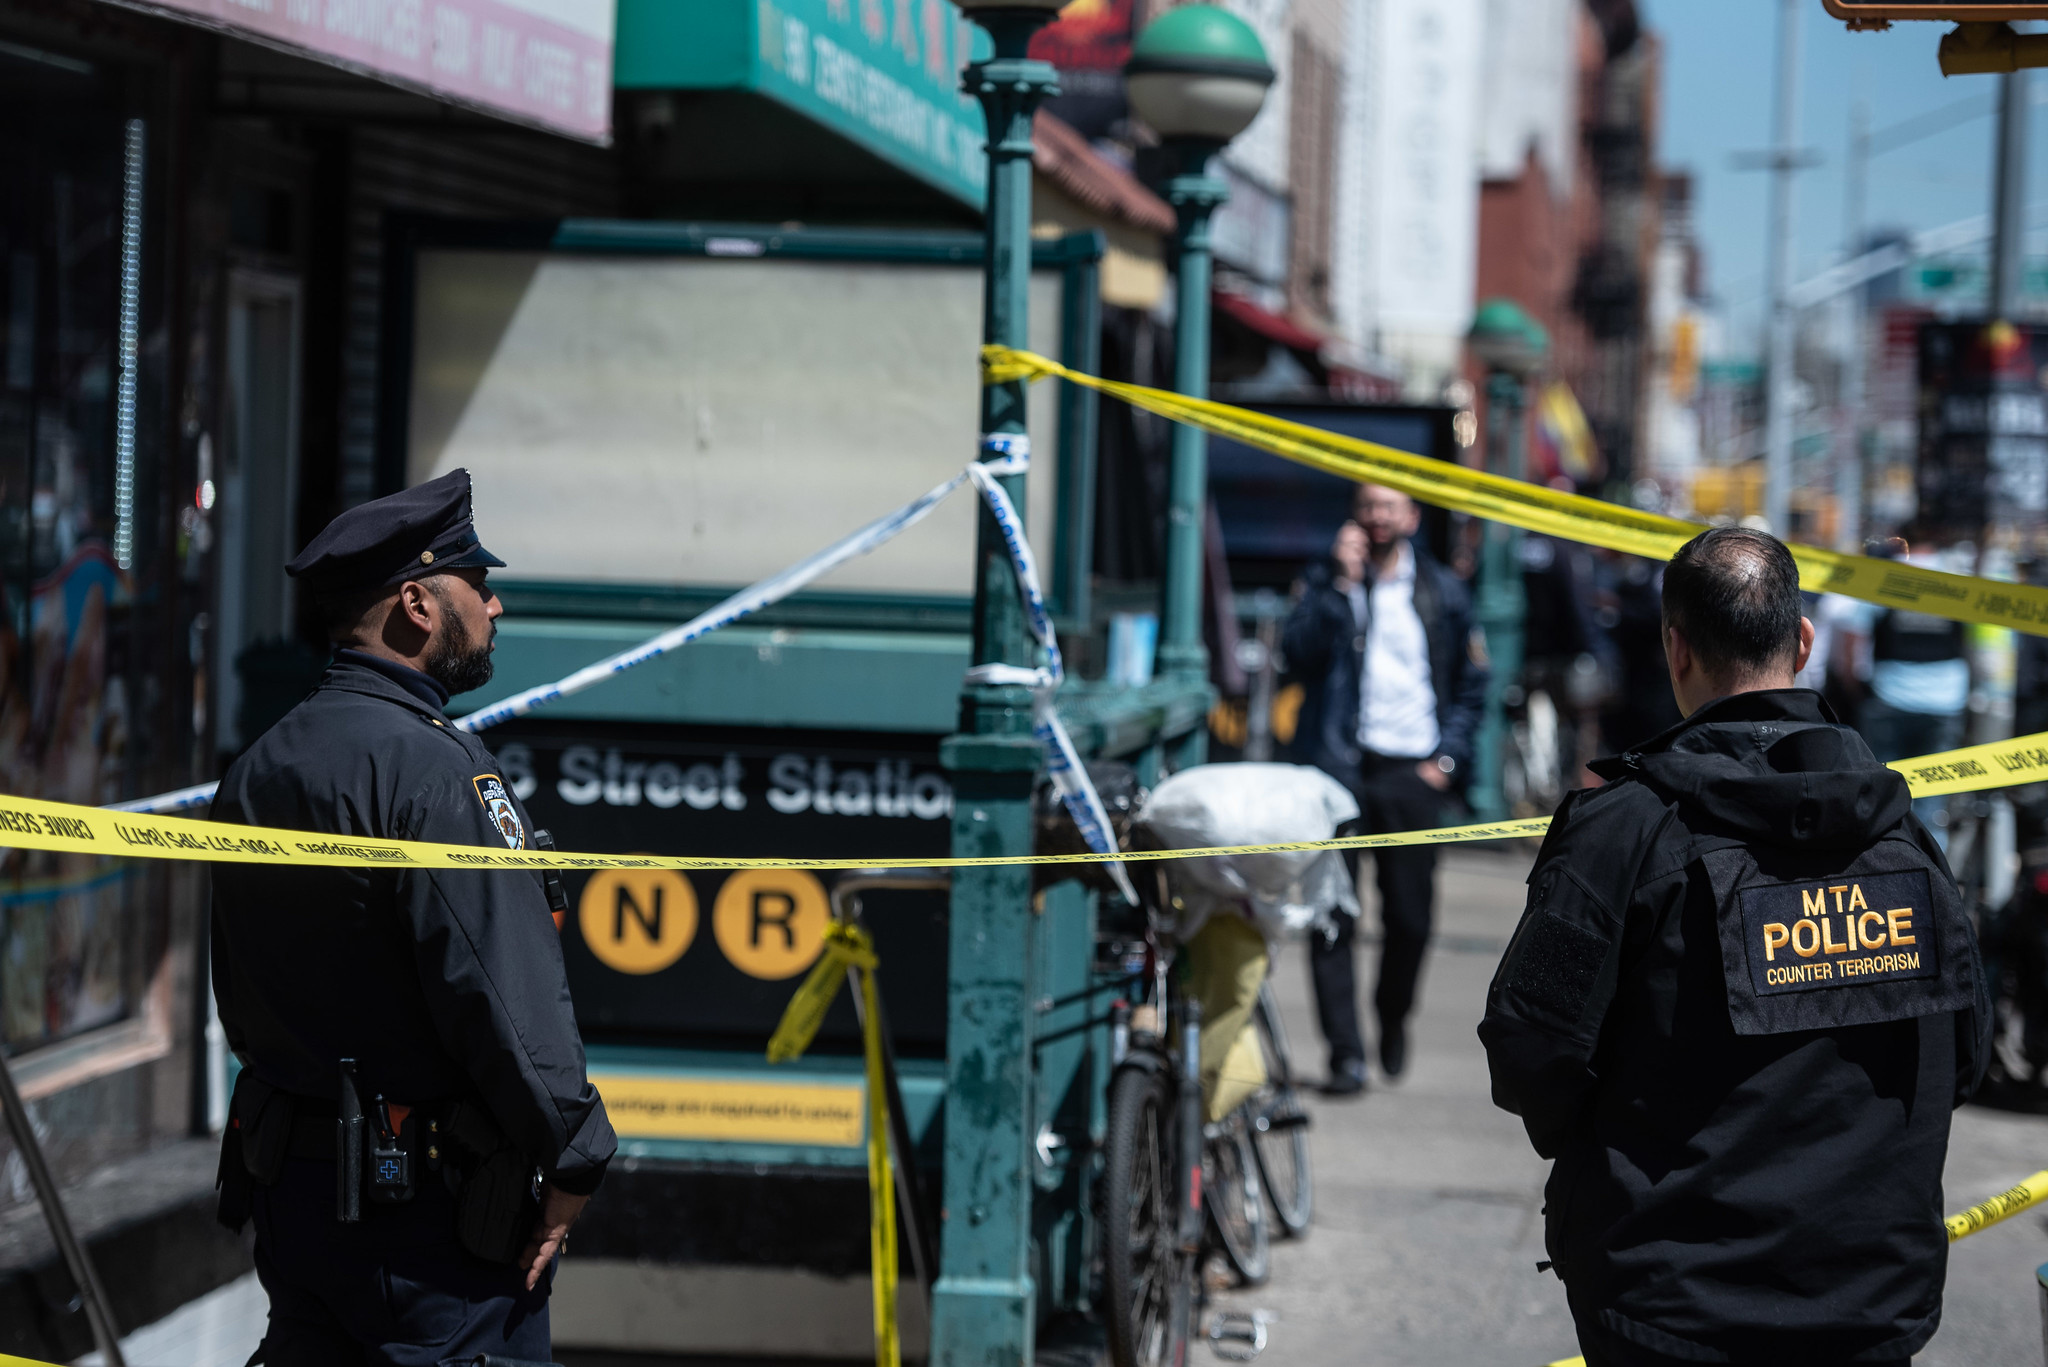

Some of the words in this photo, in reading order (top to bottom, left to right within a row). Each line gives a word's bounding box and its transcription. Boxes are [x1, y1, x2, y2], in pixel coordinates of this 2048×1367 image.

[556, 744, 747, 810] Street
[766, 752, 953, 820] Statio
[0, 810, 42, 835] SCEN
[38, 814, 95, 840] CRIME
[114, 822, 171, 849] (8477)
[446, 853, 497, 865] CROSS
[611, 882, 664, 946] N
[1801, 883, 1868, 917] MTA
[747, 888, 798, 950] R
[1763, 907, 1916, 962] POLICE
[1766, 962, 1833, 986] COUNTER
[1836, 952, 1920, 978] TERRORISM
